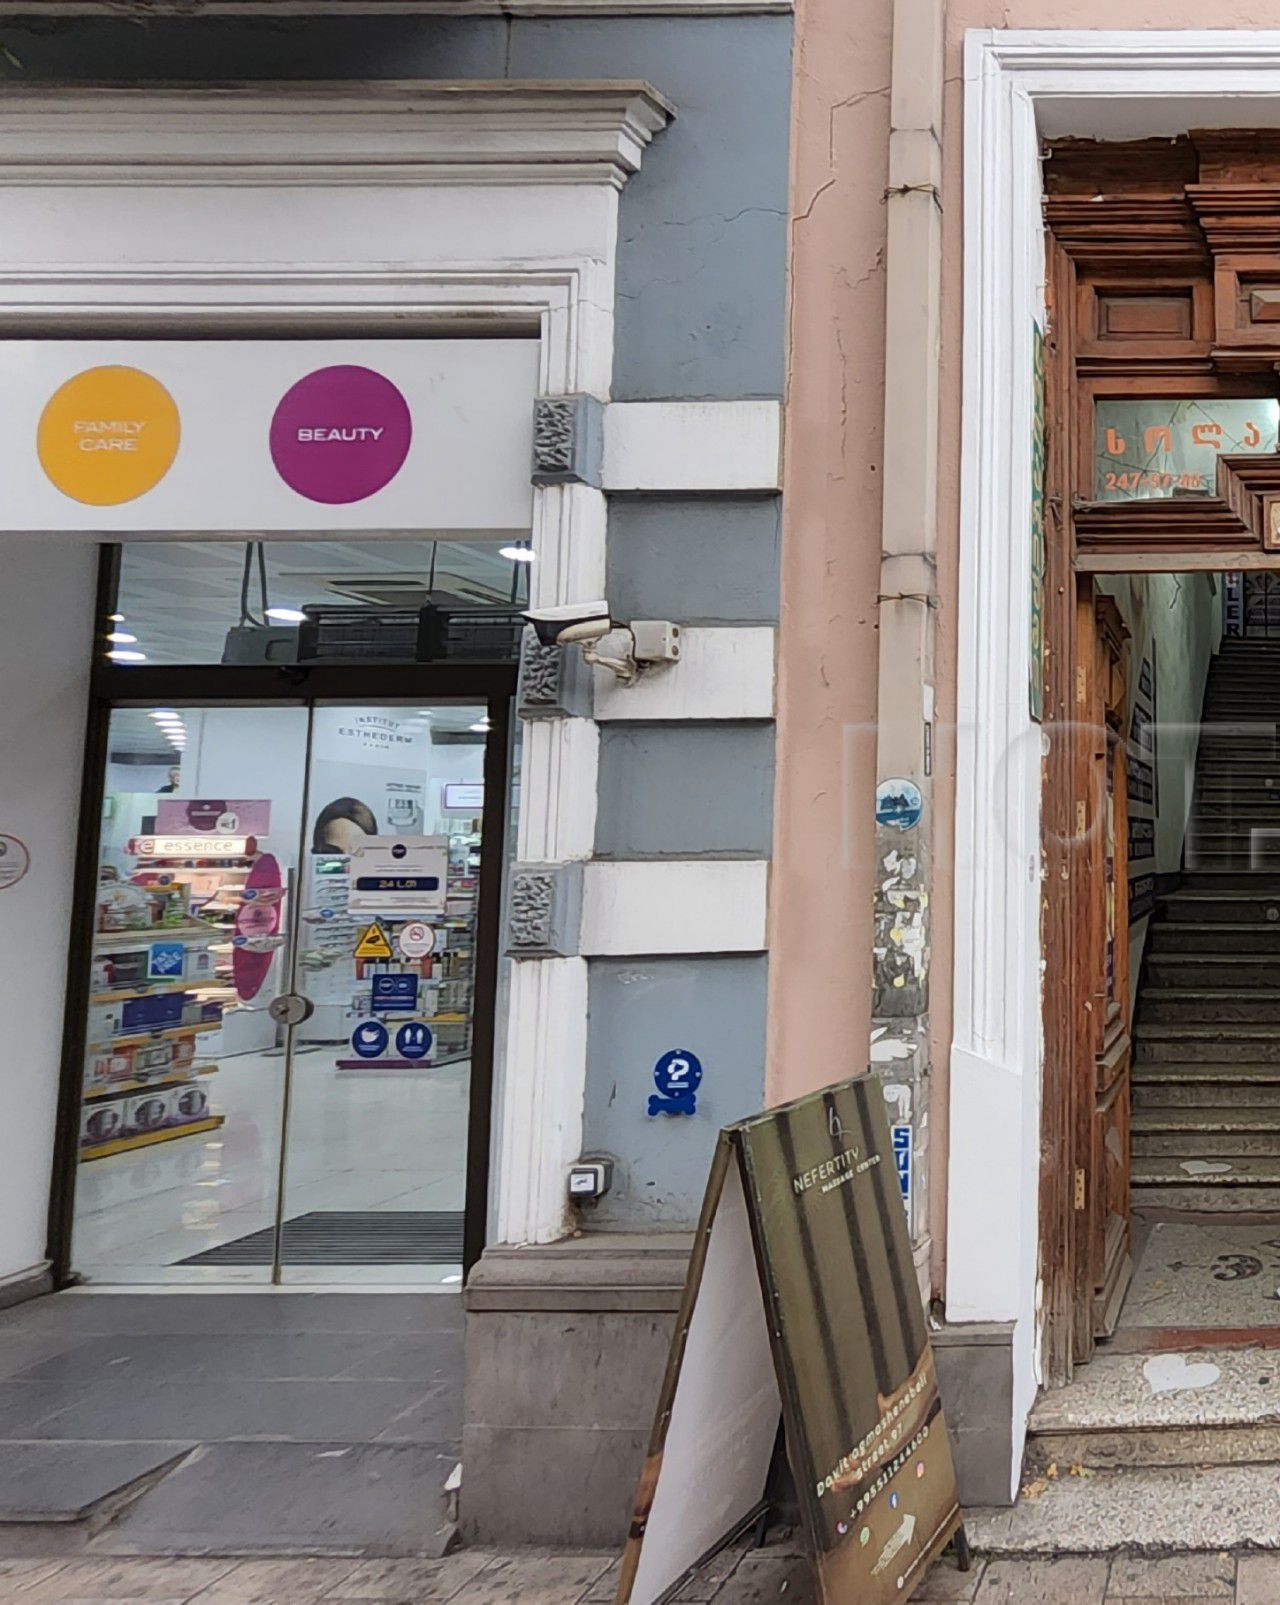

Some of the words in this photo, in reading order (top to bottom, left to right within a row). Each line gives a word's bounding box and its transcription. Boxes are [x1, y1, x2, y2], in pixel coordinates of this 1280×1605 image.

[73, 421, 145, 434] FAMILY
[298, 427, 383, 441] BEAUTY
[79, 439, 138, 451] CARE
[164, 842, 233, 852] essence
[793, 1146, 859, 1193] NEFERTITY
[821, 1169, 854, 1193] MASSAGE
[857, 1438, 890, 1480] street
[816, 1457, 849, 1498] Davit
